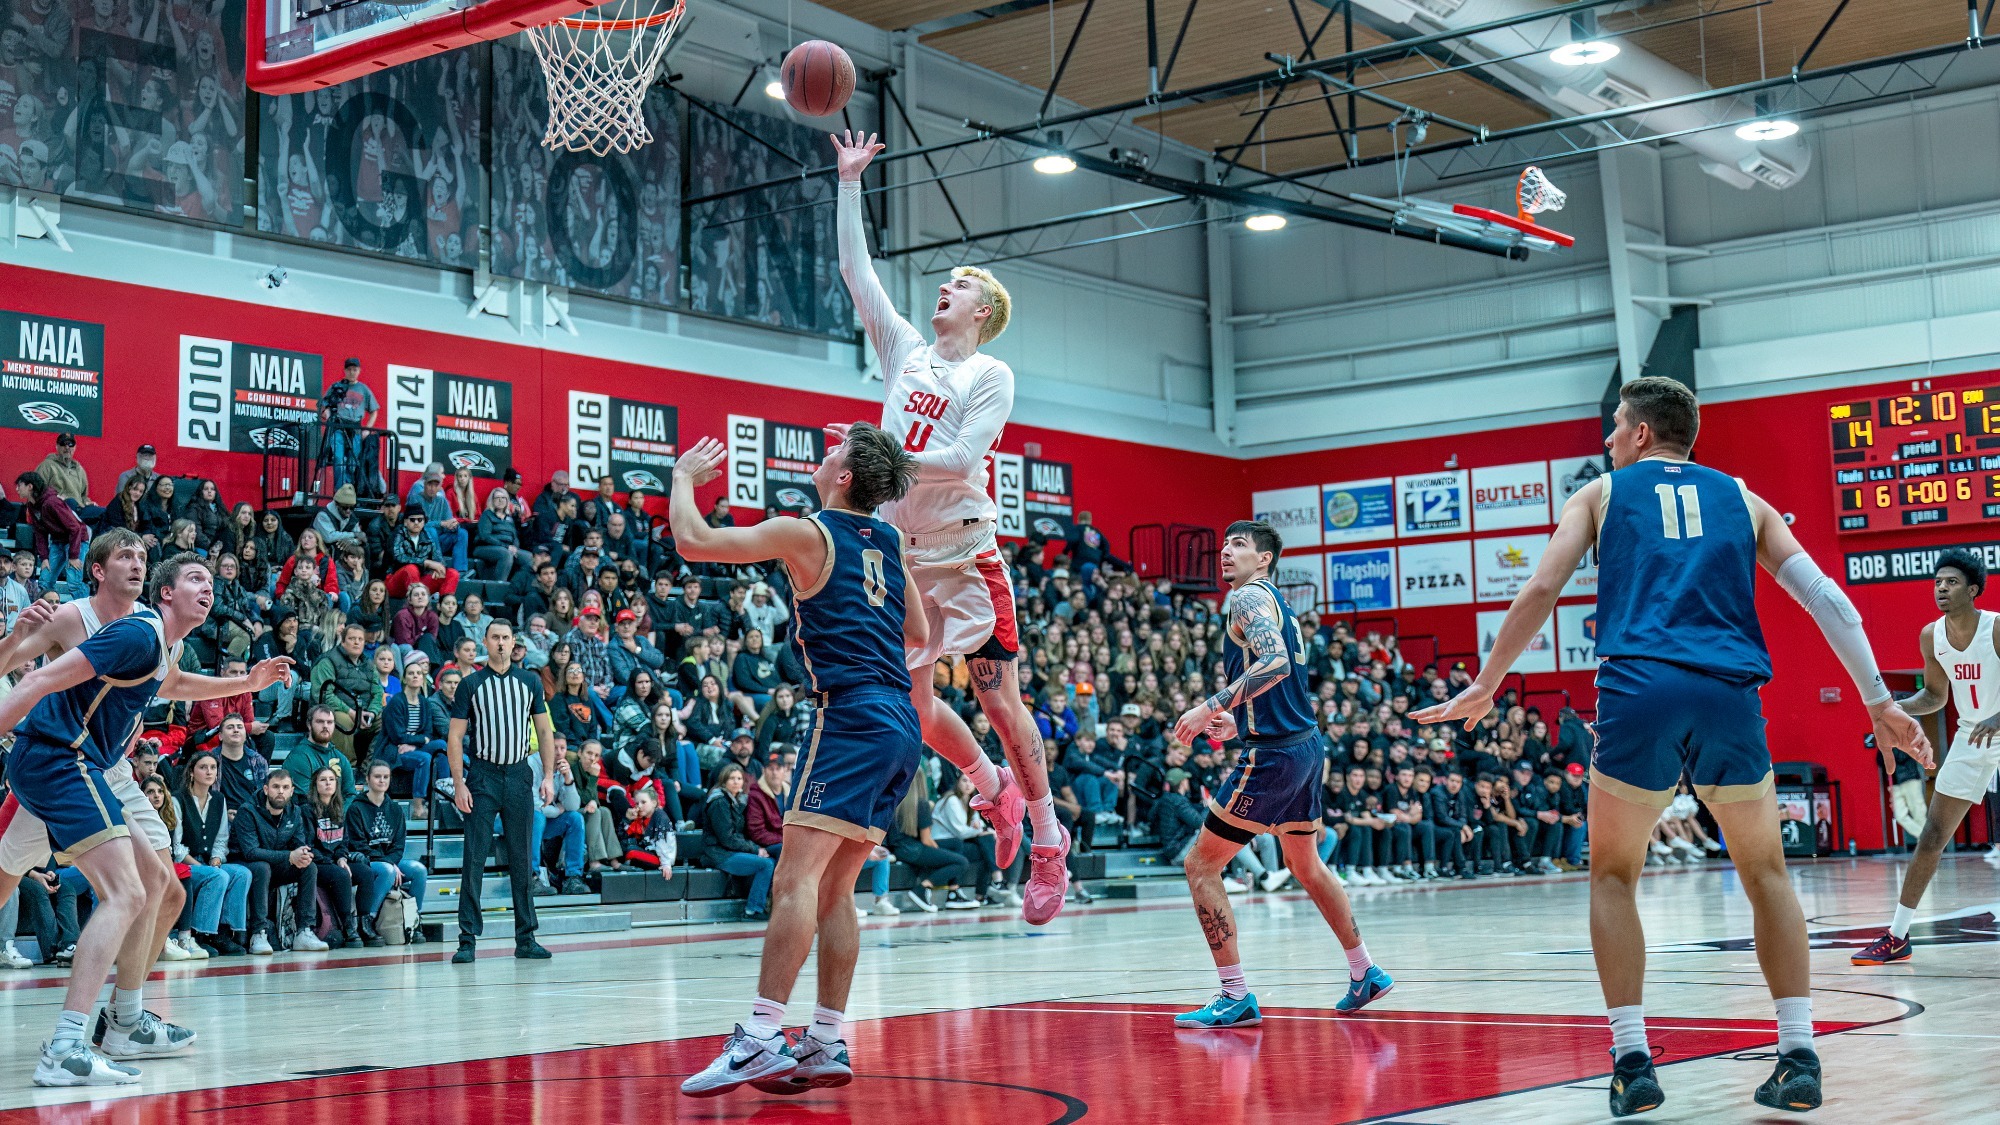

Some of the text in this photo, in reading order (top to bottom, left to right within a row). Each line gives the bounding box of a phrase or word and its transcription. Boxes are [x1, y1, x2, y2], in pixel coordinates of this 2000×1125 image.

[19, 320, 84, 366] NAIA
[7, 362, 94, 382] MEN'S CROSS COUNTRY
[249, 352, 306, 395] NAIA
[2, 374, 98, 398] NATIONAL CHAMPIONS
[188, 345, 222, 442] 2010
[247, 392, 291, 406] COMBINED
[448, 380, 498, 419] NAIA
[904, 391, 950, 420] SOU
[1889, 391, 1957, 426] 12:10
[235, 402, 318, 424] NATIONAL CHAMPIONS
[397, 374, 424, 464] 2014
[455, 418, 491, 431] FOOTBALL
[622, 404, 666, 441] NAIA
[436, 427, 509, 448] NATIONAL CHAMPIONS
[577, 399, 601, 484] 2016
[774, 426, 815, 462] NAIA
[1848, 420, 1873, 448] 14
[1955, 434, 1962, 453] 1
[1903, 440, 1937, 458] period
[736, 423, 758, 501] 2018
[1903, 463, 1939, 478] player
[1032, 463, 1065, 495] NAIA
[1956, 478, 1971, 500] 6
[1001, 460, 1020, 530] 2021
[1475, 483, 1545, 503] BUTLER
[1855, 489, 1862, 508] 1
[1875, 485, 1891, 508] 6
[1406, 489, 1453, 524] 12
[1655, 484, 1703, 540] 11
[862, 549, 888, 607] 0
[1332, 560, 1390, 582] Flagship
[1848, 554, 1887, 580] BOB
[1350, 582, 1374, 599] Inn
[1406, 573, 1466, 590] PIZZA
[1954, 663, 1981, 680] SOU
[1970, 684, 1979, 709] 1
[804, 781, 826, 809] E
[1234, 795, 1254, 817] E
